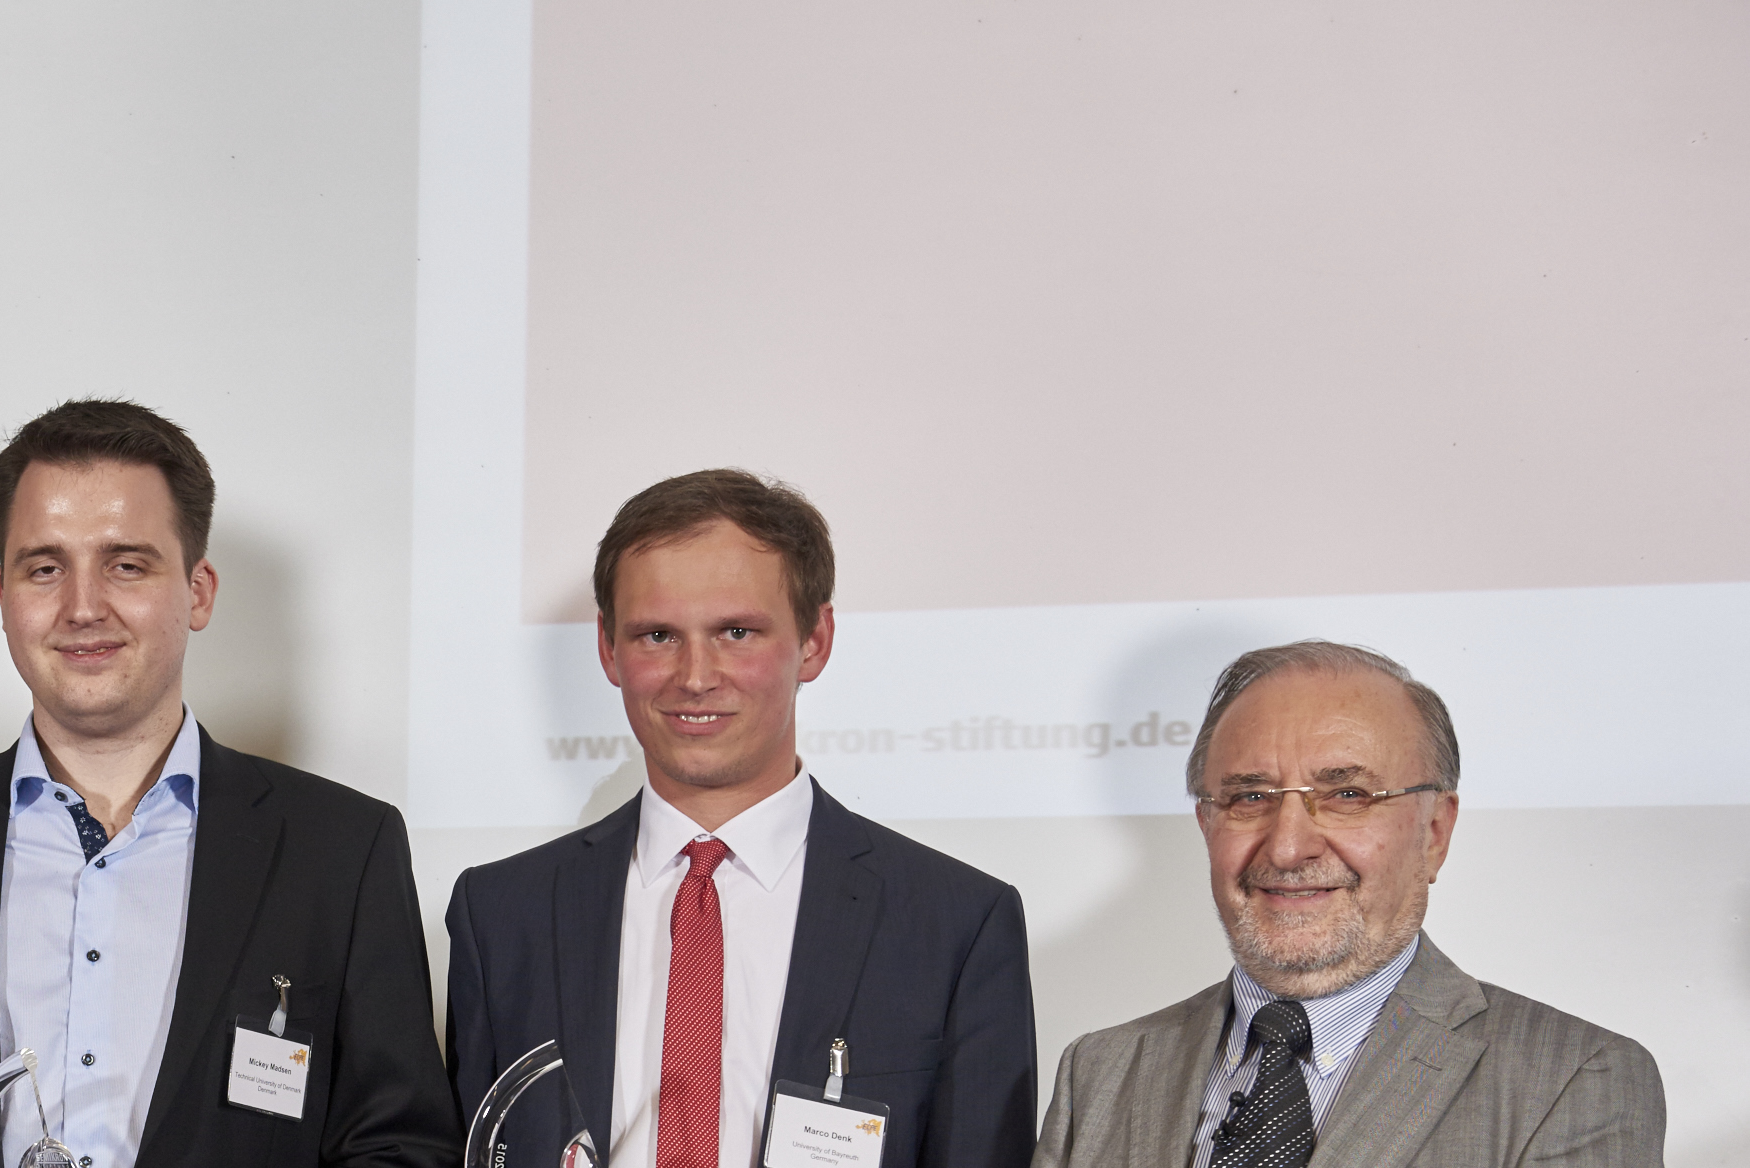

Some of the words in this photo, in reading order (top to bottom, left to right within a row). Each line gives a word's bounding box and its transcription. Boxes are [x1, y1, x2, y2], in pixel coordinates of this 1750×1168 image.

[249, 1057, 269, 1070] Mickey
[270, 1063, 292, 1075] Madsen
[235, 1071, 256, 1082] Technical
[256, 1077, 277, 1089] University
[283, 1084, 302, 1094] Denmark
[257, 1086, 277, 1096] Denmark
[804, 1125, 829, 1138] Marco
[831, 1131, 853, 1143] Denk
[792, 1140, 822, 1154] University
[823, 1148, 831, 1156] of
[831, 1149, 859, 1161] Bayreuth
[810, 1153, 839, 1165] Germany
